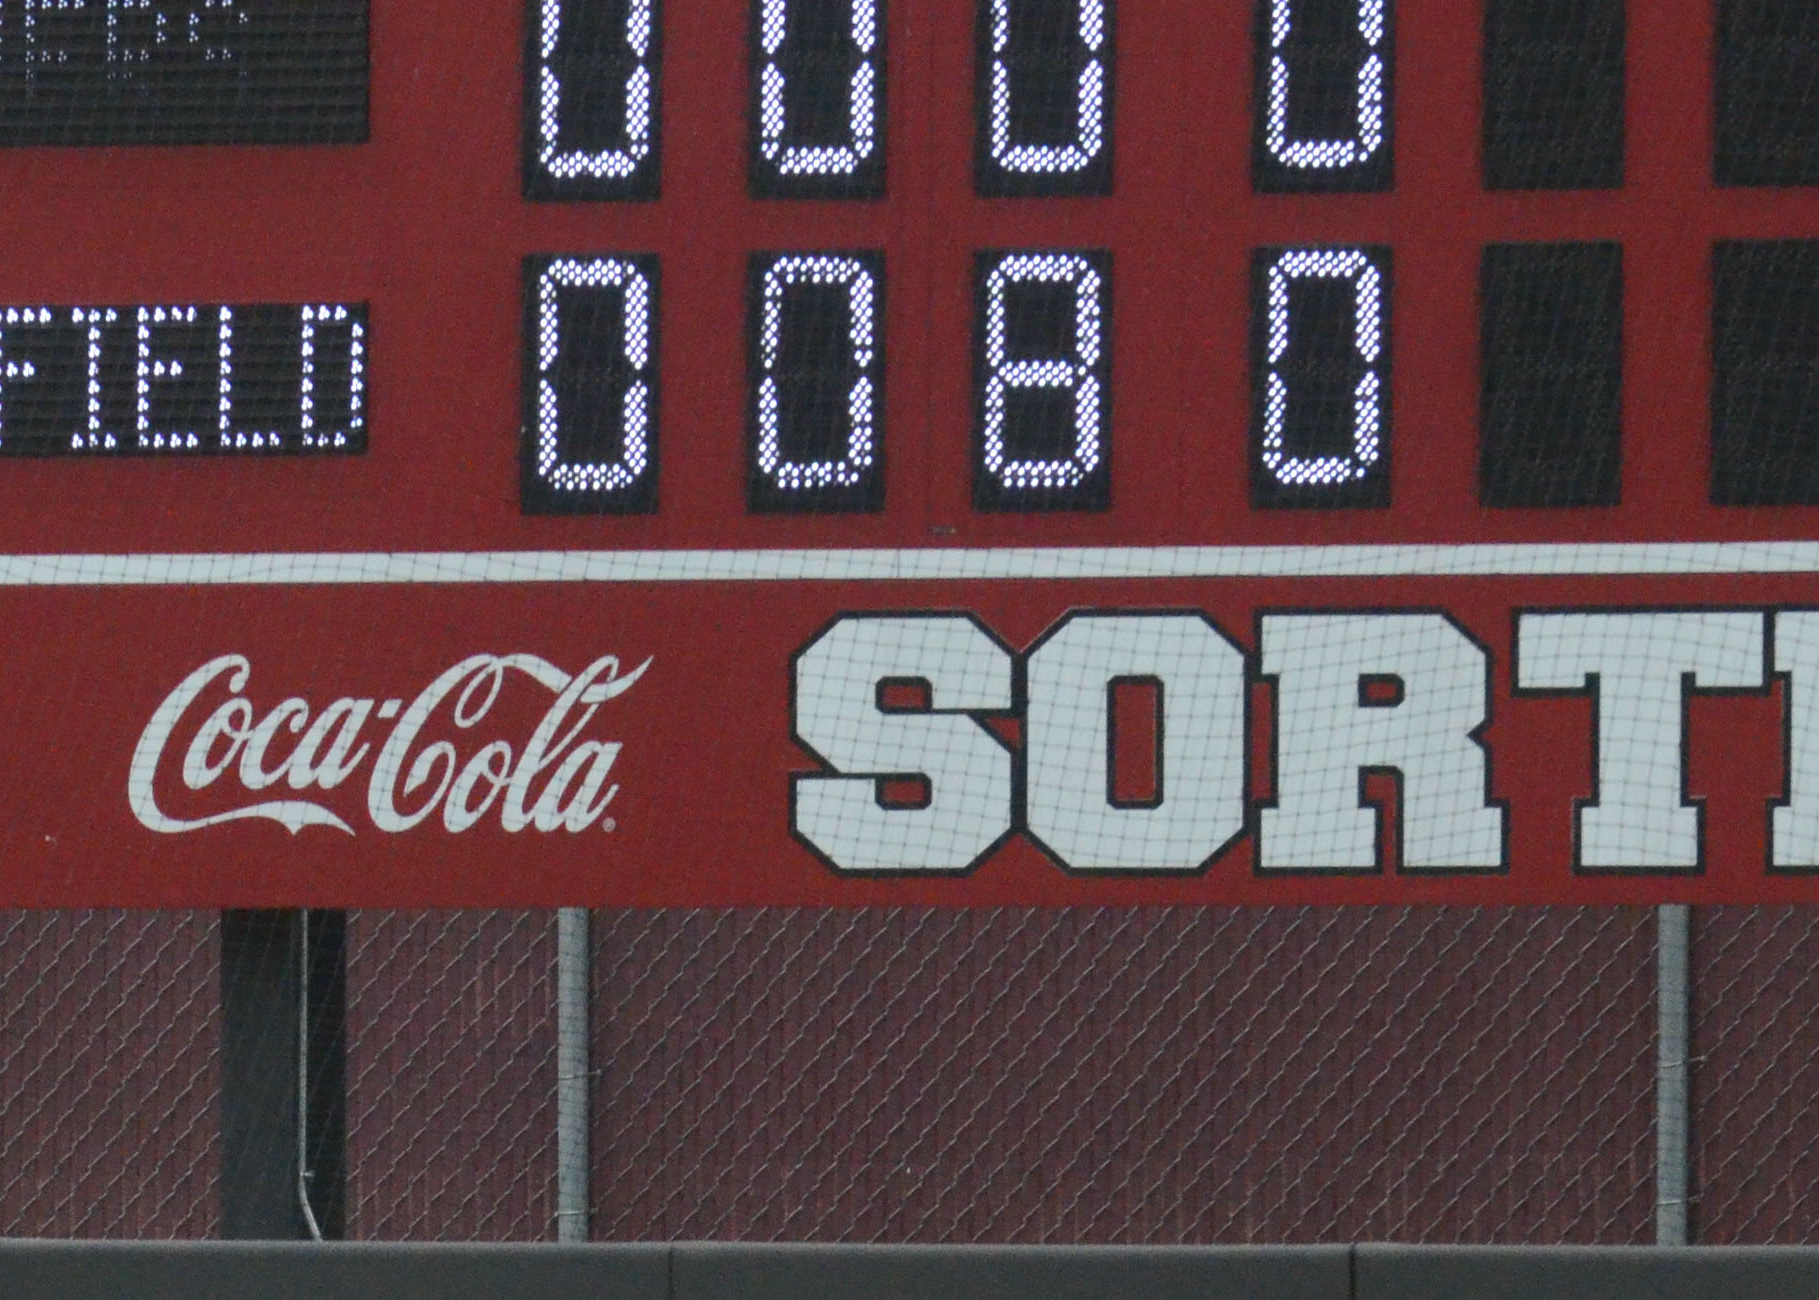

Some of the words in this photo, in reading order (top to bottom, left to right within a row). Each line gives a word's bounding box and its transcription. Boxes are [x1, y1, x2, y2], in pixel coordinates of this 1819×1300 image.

[539, 259, 649, 490] 0
[759, 256, 875, 488] 0
[984, 254, 1100, 487] 8
[1262, 251, 1381, 485] 0
[126, 652, 655, 835] Coca-Cola
